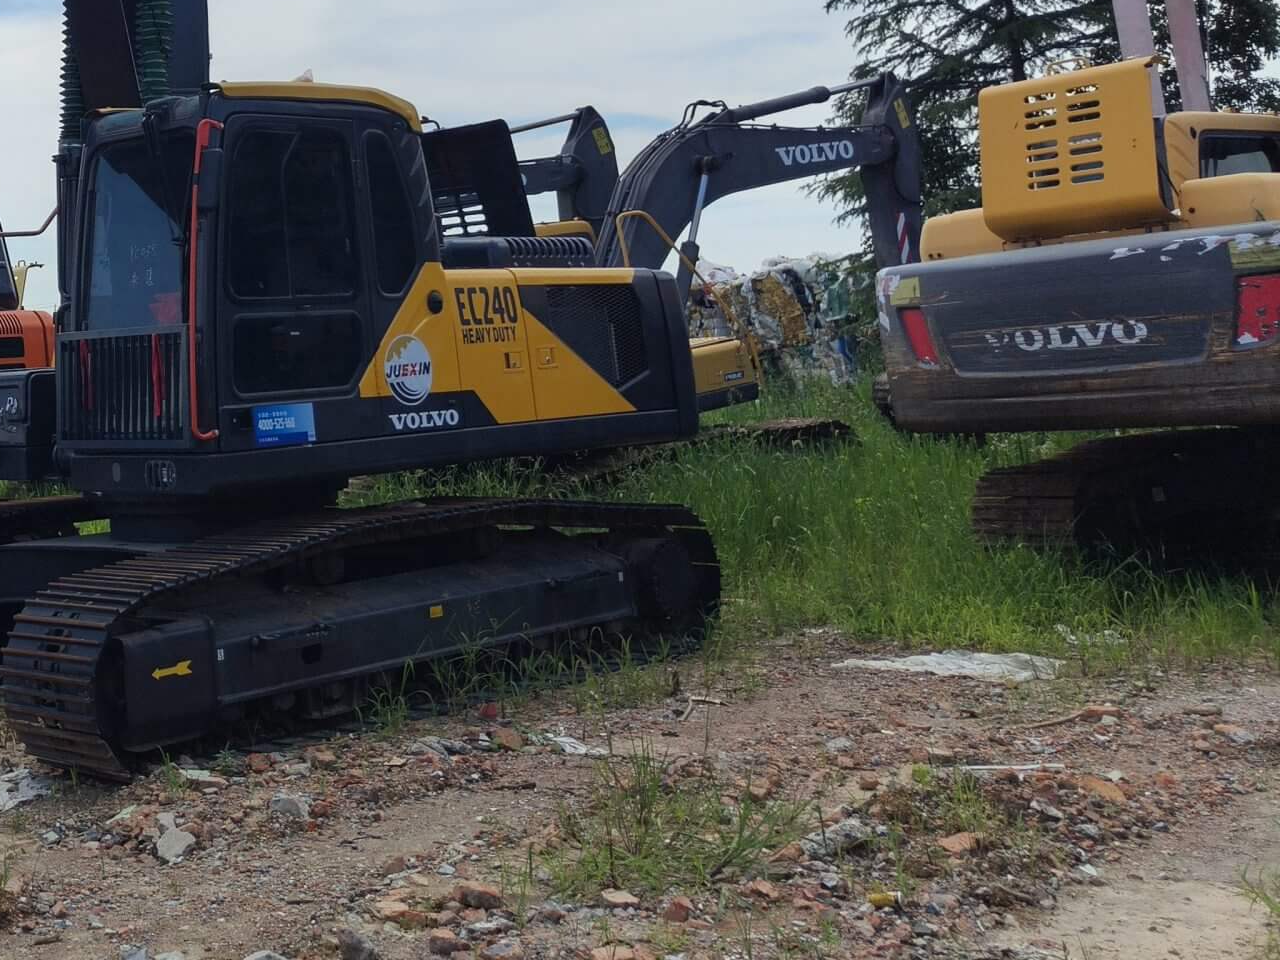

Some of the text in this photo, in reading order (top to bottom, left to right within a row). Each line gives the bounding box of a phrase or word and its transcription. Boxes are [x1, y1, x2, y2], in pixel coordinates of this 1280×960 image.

[775, 140, 854, 166] VOLVO
[454, 286, 518, 326] EC240
[462, 326, 517, 344] HEAVY DUTY
[386, 361, 431, 379] JUEXIN
[388, 409, 460, 430] VOLVO
